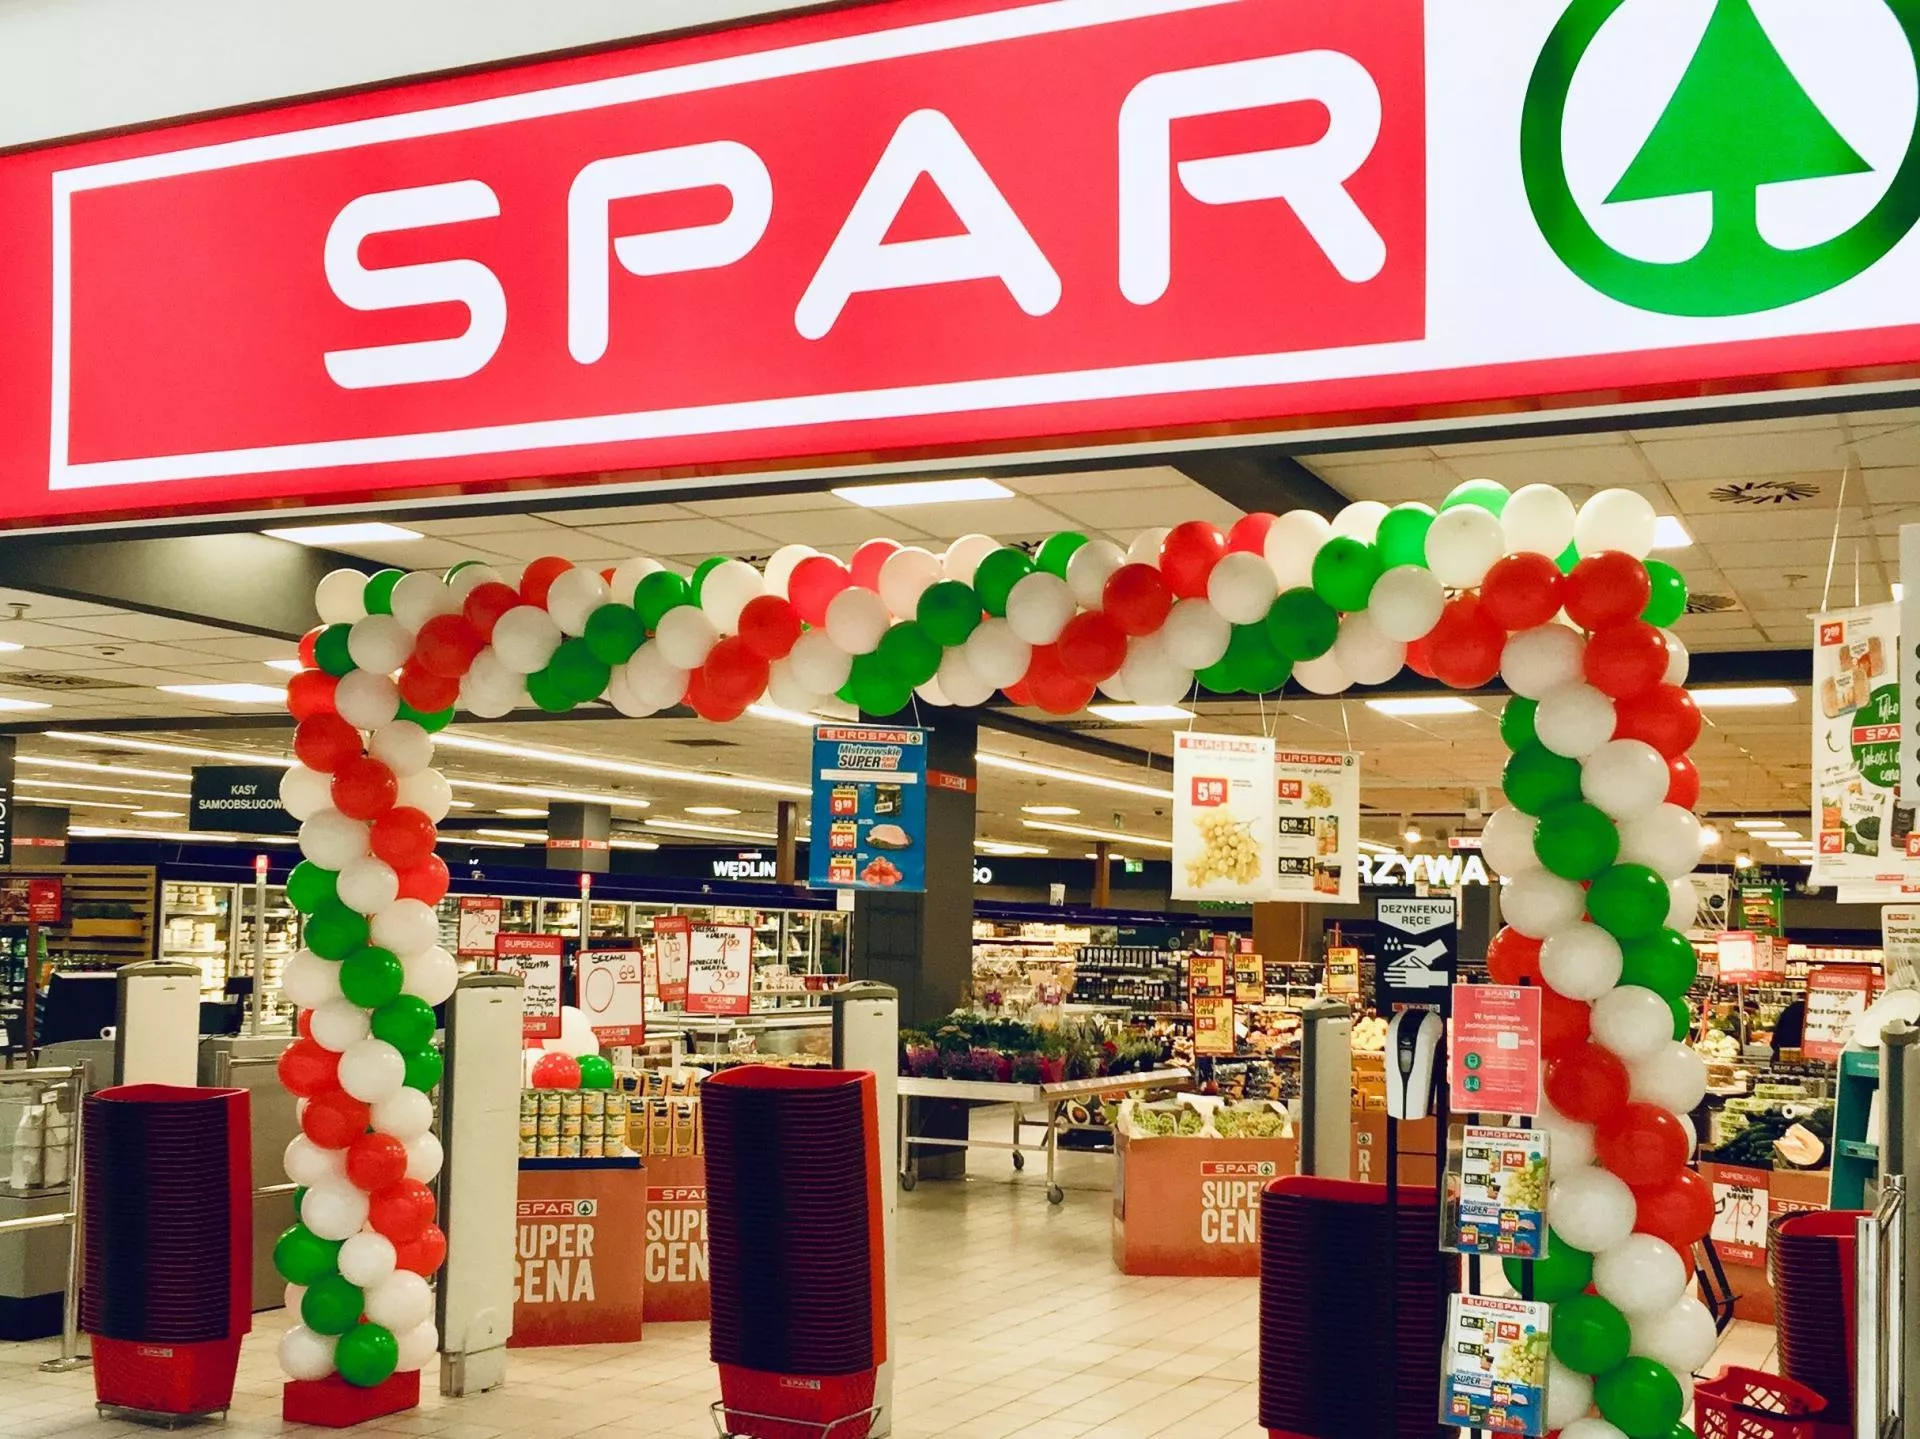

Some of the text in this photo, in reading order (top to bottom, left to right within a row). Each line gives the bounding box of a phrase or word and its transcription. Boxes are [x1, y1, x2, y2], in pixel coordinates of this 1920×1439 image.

[323, 48, 1387, 390] SPAR
[826, 728, 908, 742] EUROSPAR
[1187, 739, 1257, 753] EUROSPAR
[839, 755, 881, 768] SUPER
[1275, 752, 1343, 765] EUROSPAR
[231, 785, 258, 795] KASY
[713, 861, 777, 881] WĘDLIN
[1380, 904, 1452, 915] DEZYNFEKUJ
[1401, 916, 1431, 927] RĘCE
[1196, 999, 1224, 1008] SUPER
[1471, 1130, 1530, 1140] EUROSPAR
[1215, 1164, 1258, 1174] SPAR
[1202, 1180, 1268, 1209] SUPE
[518, 1203, 574, 1215] SPAR
[1201, 1209, 1262, 1244] CEN
[514, 1223, 594, 1259] UPER
[1467, 1297, 1526, 1312] EUROSPAR
[1455, 1374, 1481, 1385] SUPER
